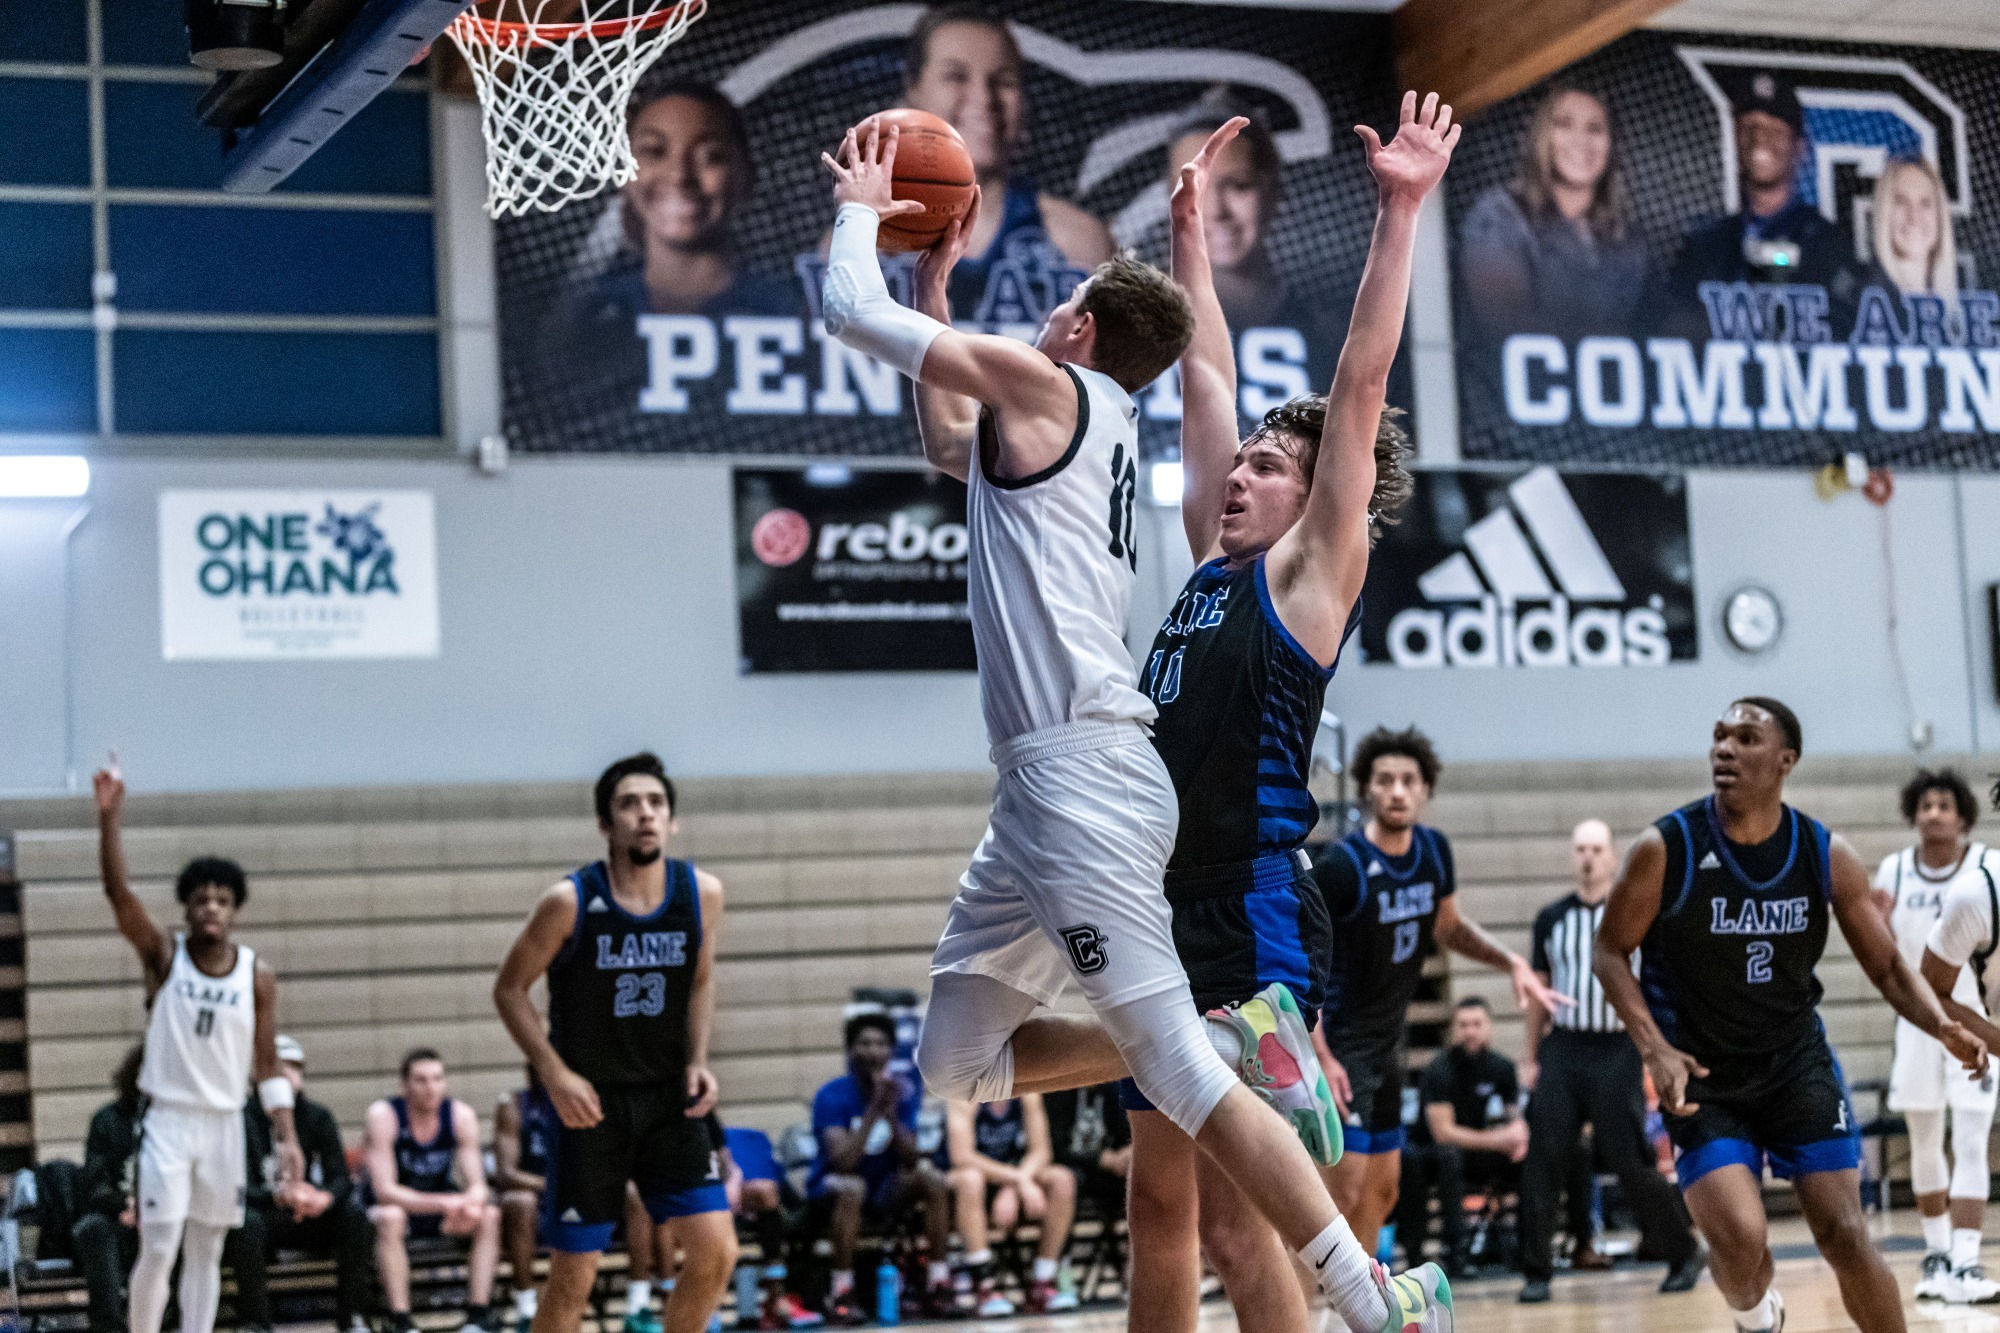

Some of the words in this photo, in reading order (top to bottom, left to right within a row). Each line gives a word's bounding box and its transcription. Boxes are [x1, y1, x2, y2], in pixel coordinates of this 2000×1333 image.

[1697, 279, 1833, 345] WE
[1848, 284, 2000, 351] ARE
[1502, 333, 2000, 434] COMMUN
[196, 514, 309, 553] ONE
[815, 511, 969, 562] rebo
[197, 556, 400, 597] OHANA
[1386, 595, 1672, 667] adidas
[1378, 881, 1434, 924] LANE
[1710, 896, 1809, 934] LANE
[1906, 892, 1942, 910] CLA
[595, 931, 687, 969] LANE
[1745, 941, 1774, 984] 2
[613, 971, 667, 1018] 23
